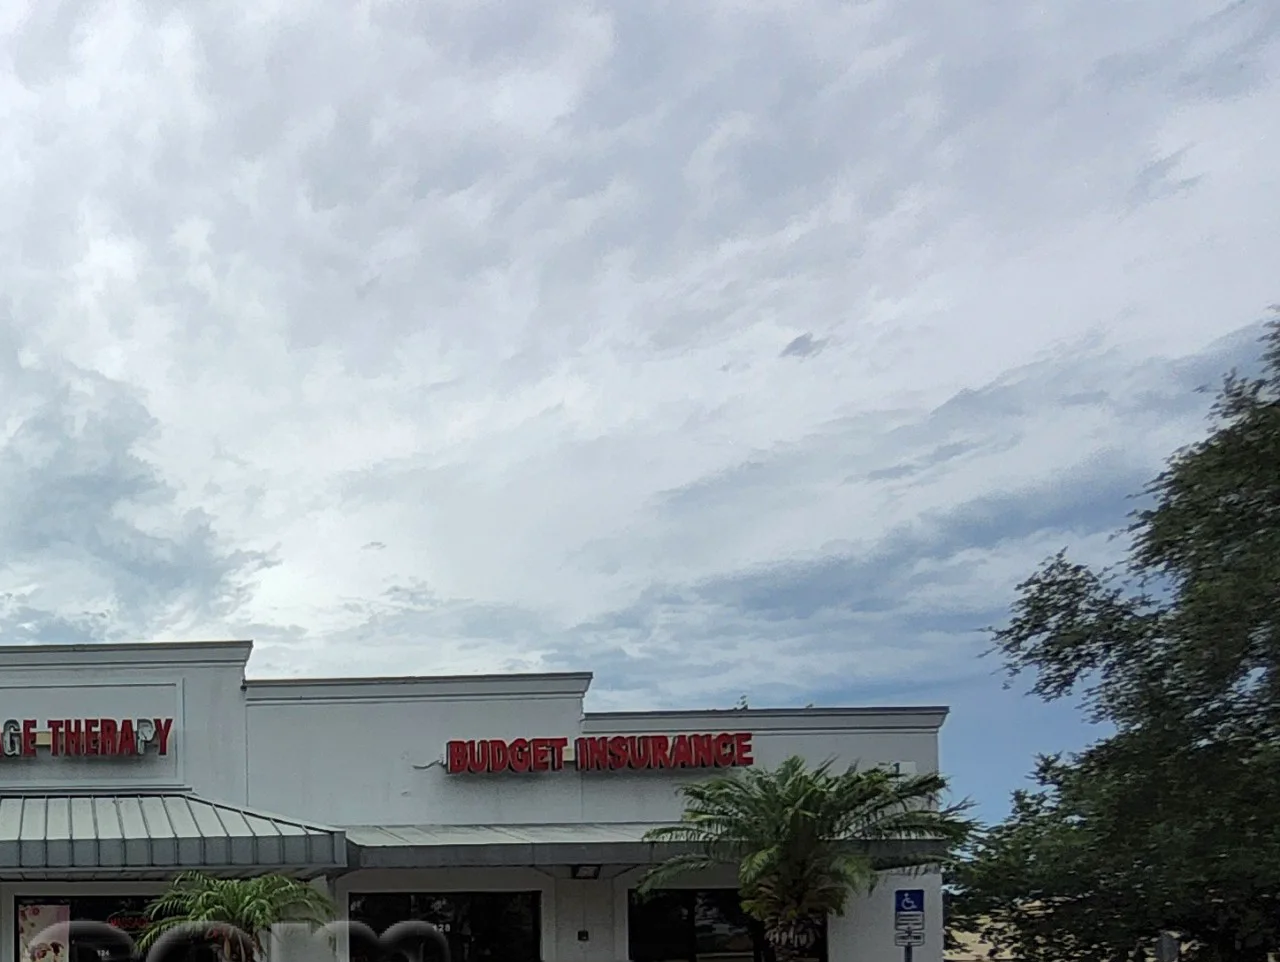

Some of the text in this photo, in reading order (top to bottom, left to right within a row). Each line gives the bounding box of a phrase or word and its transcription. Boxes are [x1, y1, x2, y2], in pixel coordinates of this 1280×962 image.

[47, 718, 173, 756] THERAPY
[447, 732, 755, 774] BUDGET INSURANCE
